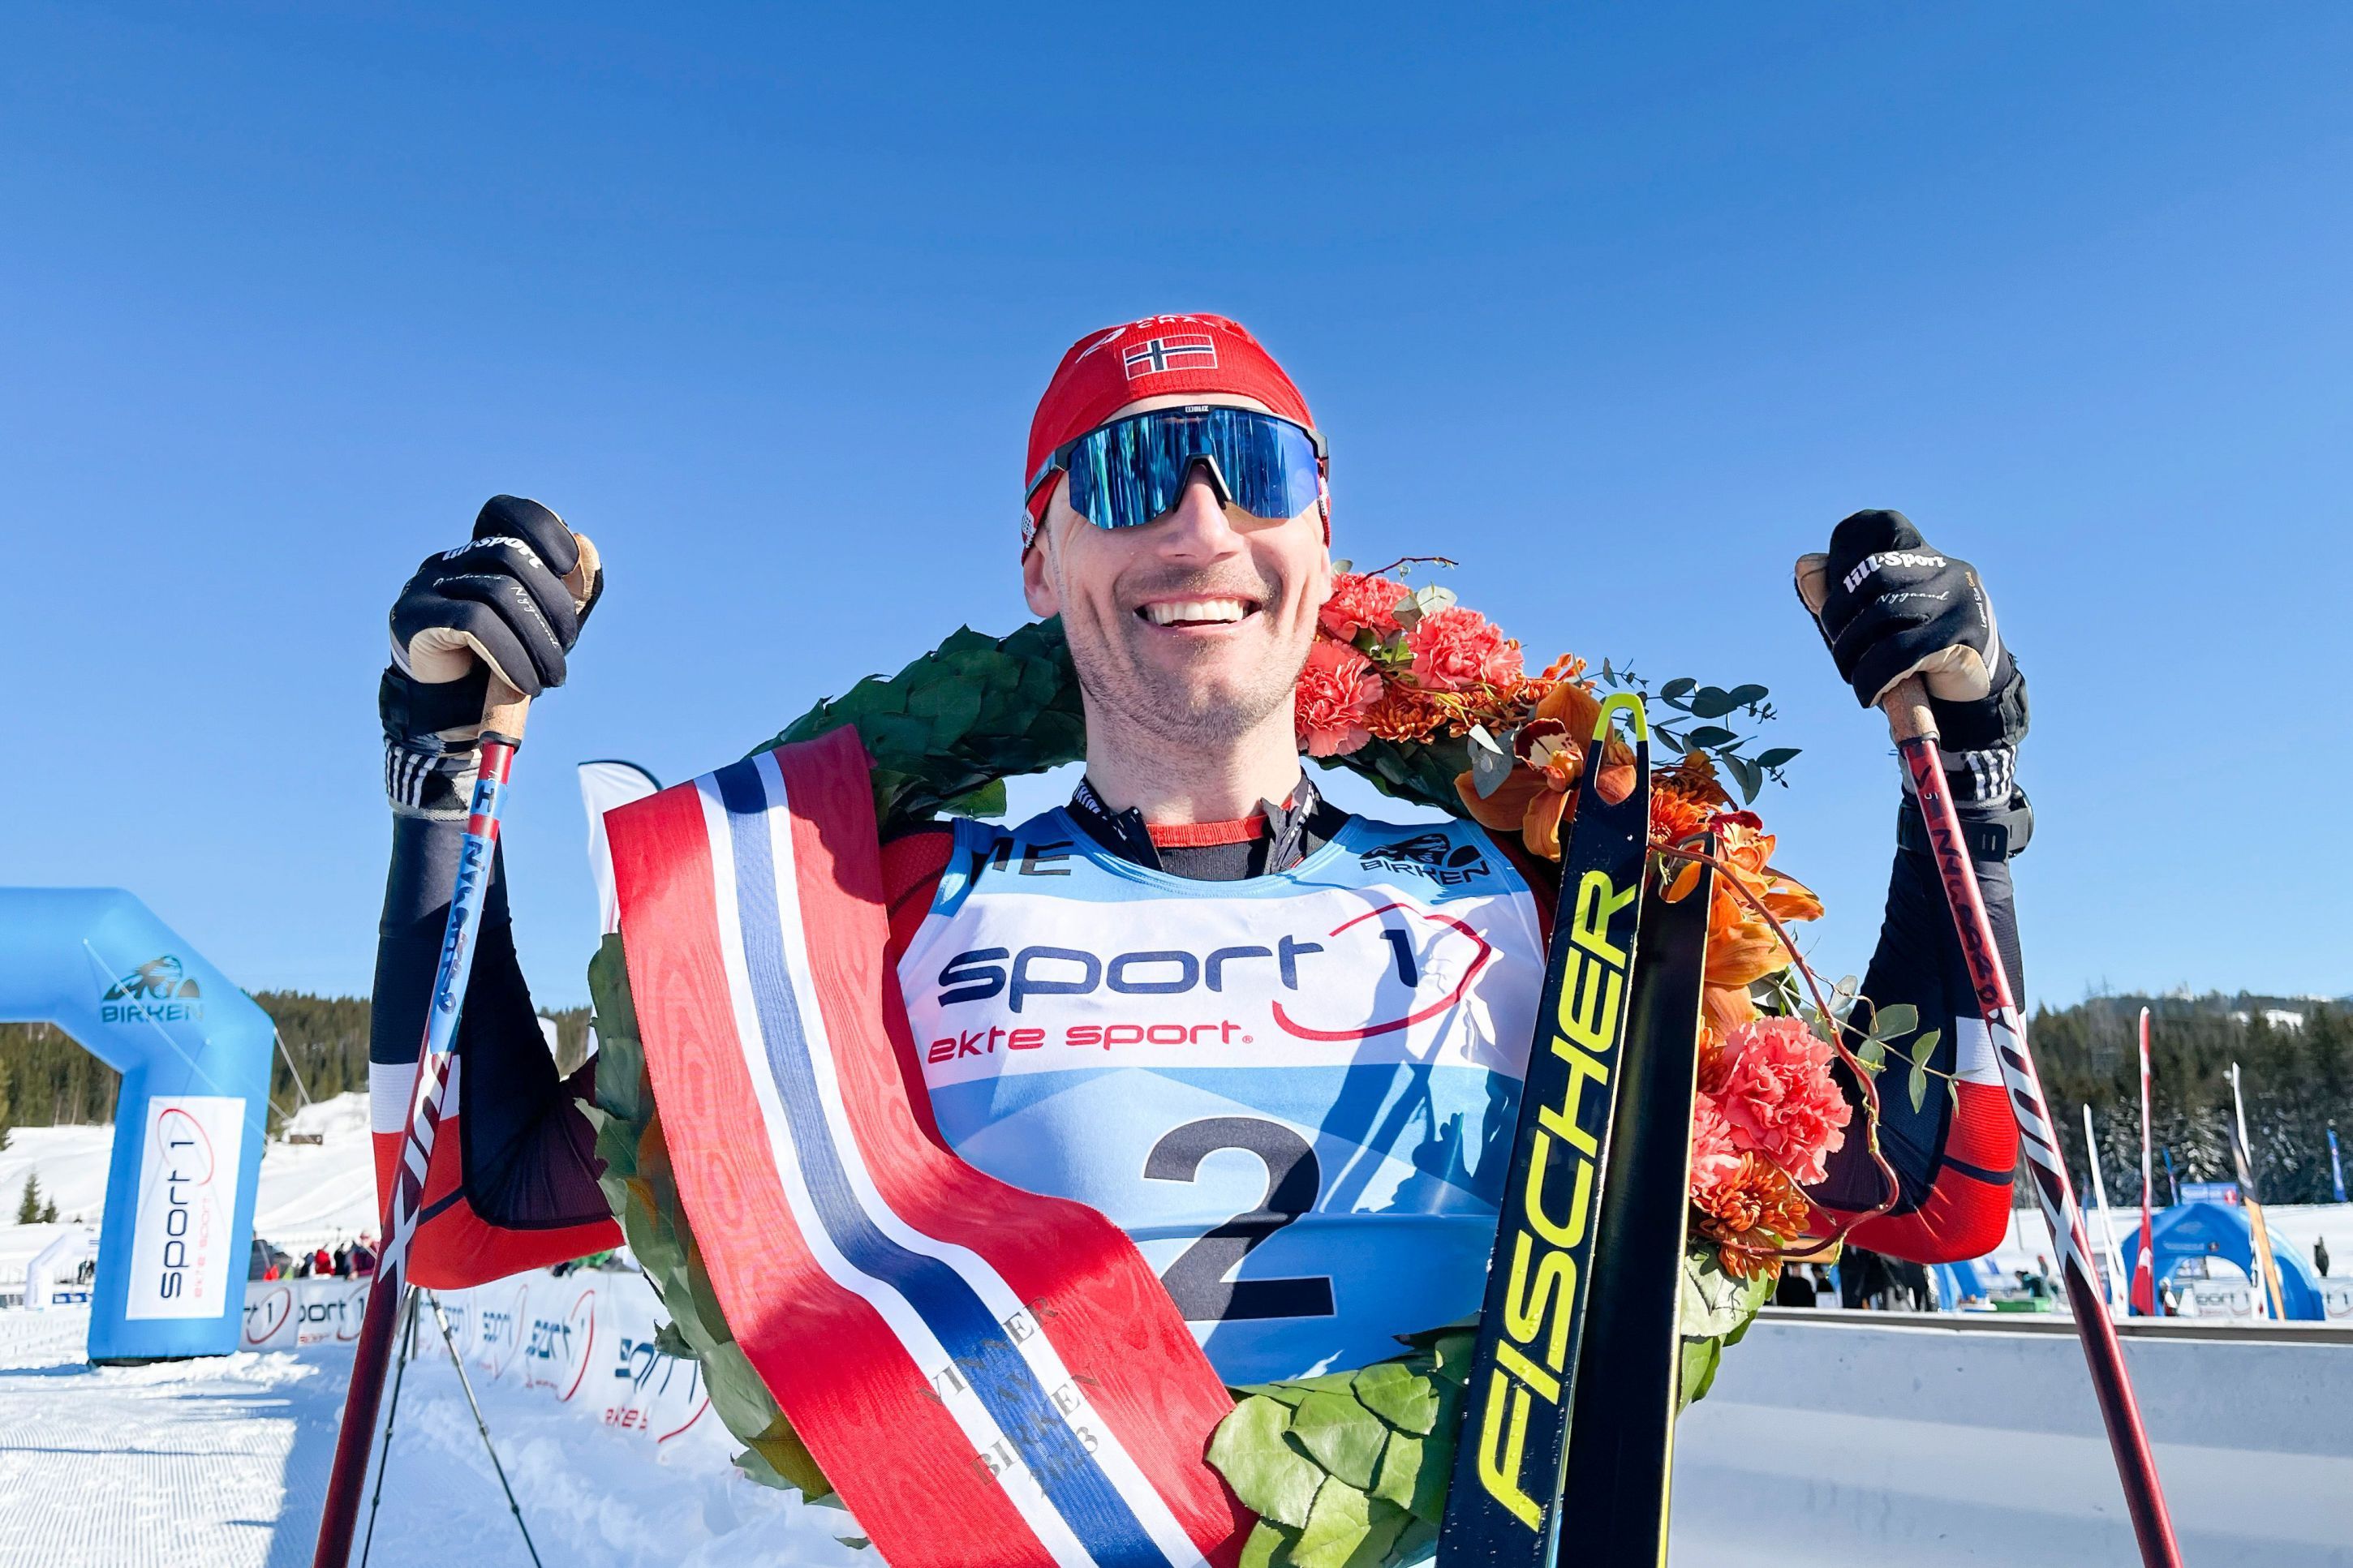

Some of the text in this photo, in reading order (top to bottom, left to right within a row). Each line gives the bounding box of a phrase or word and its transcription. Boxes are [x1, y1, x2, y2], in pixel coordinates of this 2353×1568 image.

[1361, 860, 1491, 885] BIRKEN
[101, 1003, 203, 1022] BIRKEN
[938, 929, 1418, 1013] sport 1
[928, 1025, 1044, 1064] ekte
[161, 1170, 191, 1298] sport
[1143, 1117, 1335, 1321] 2
[1478, 870, 1637, 1532] FISCHER
